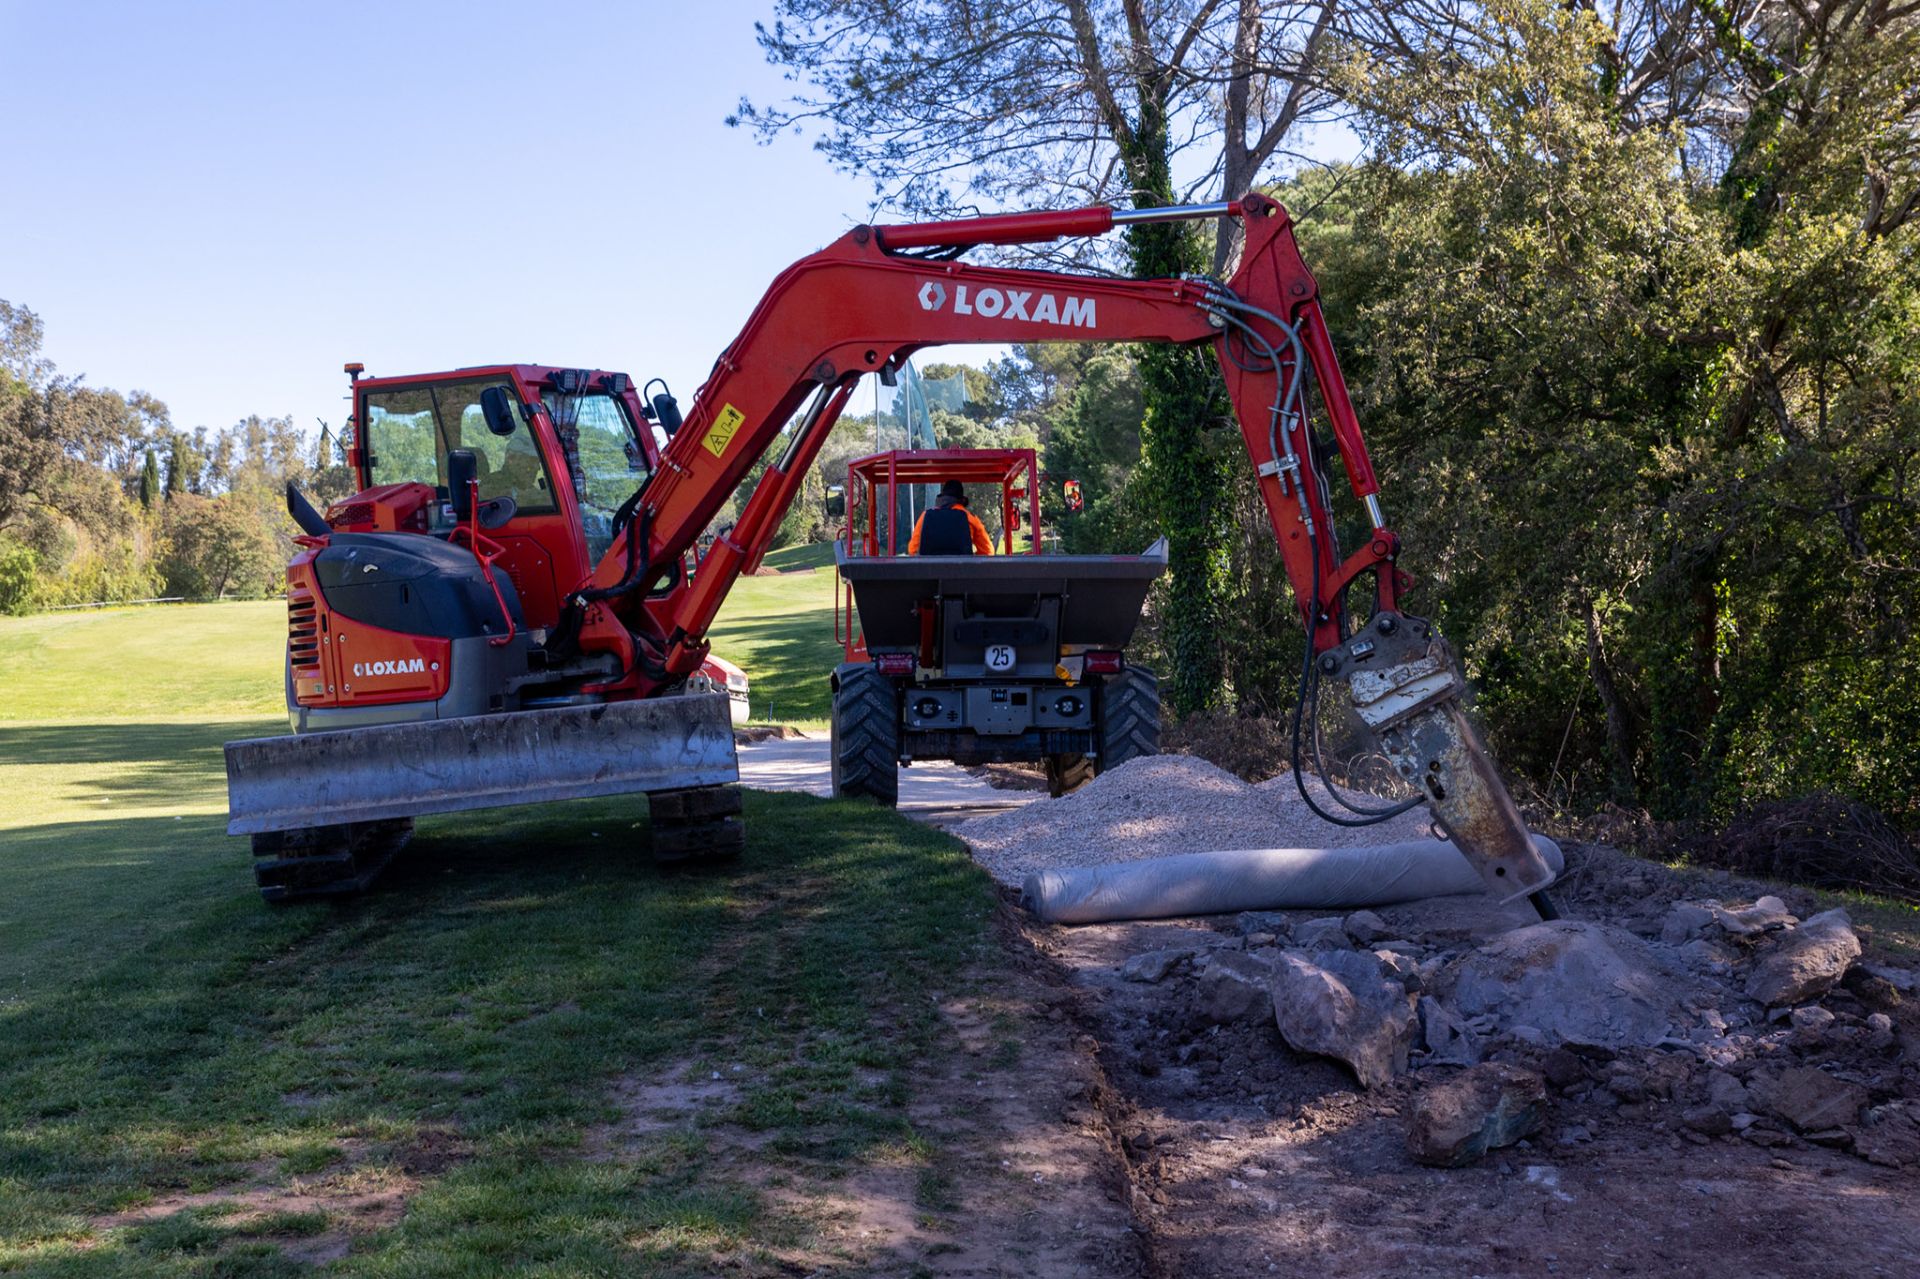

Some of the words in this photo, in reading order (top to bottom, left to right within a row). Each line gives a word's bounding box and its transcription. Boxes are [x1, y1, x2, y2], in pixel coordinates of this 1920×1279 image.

[954, 285, 1096, 328] LOXAM
[992, 647, 1009, 666] 25
[365, 658, 425, 676] LOXAM
